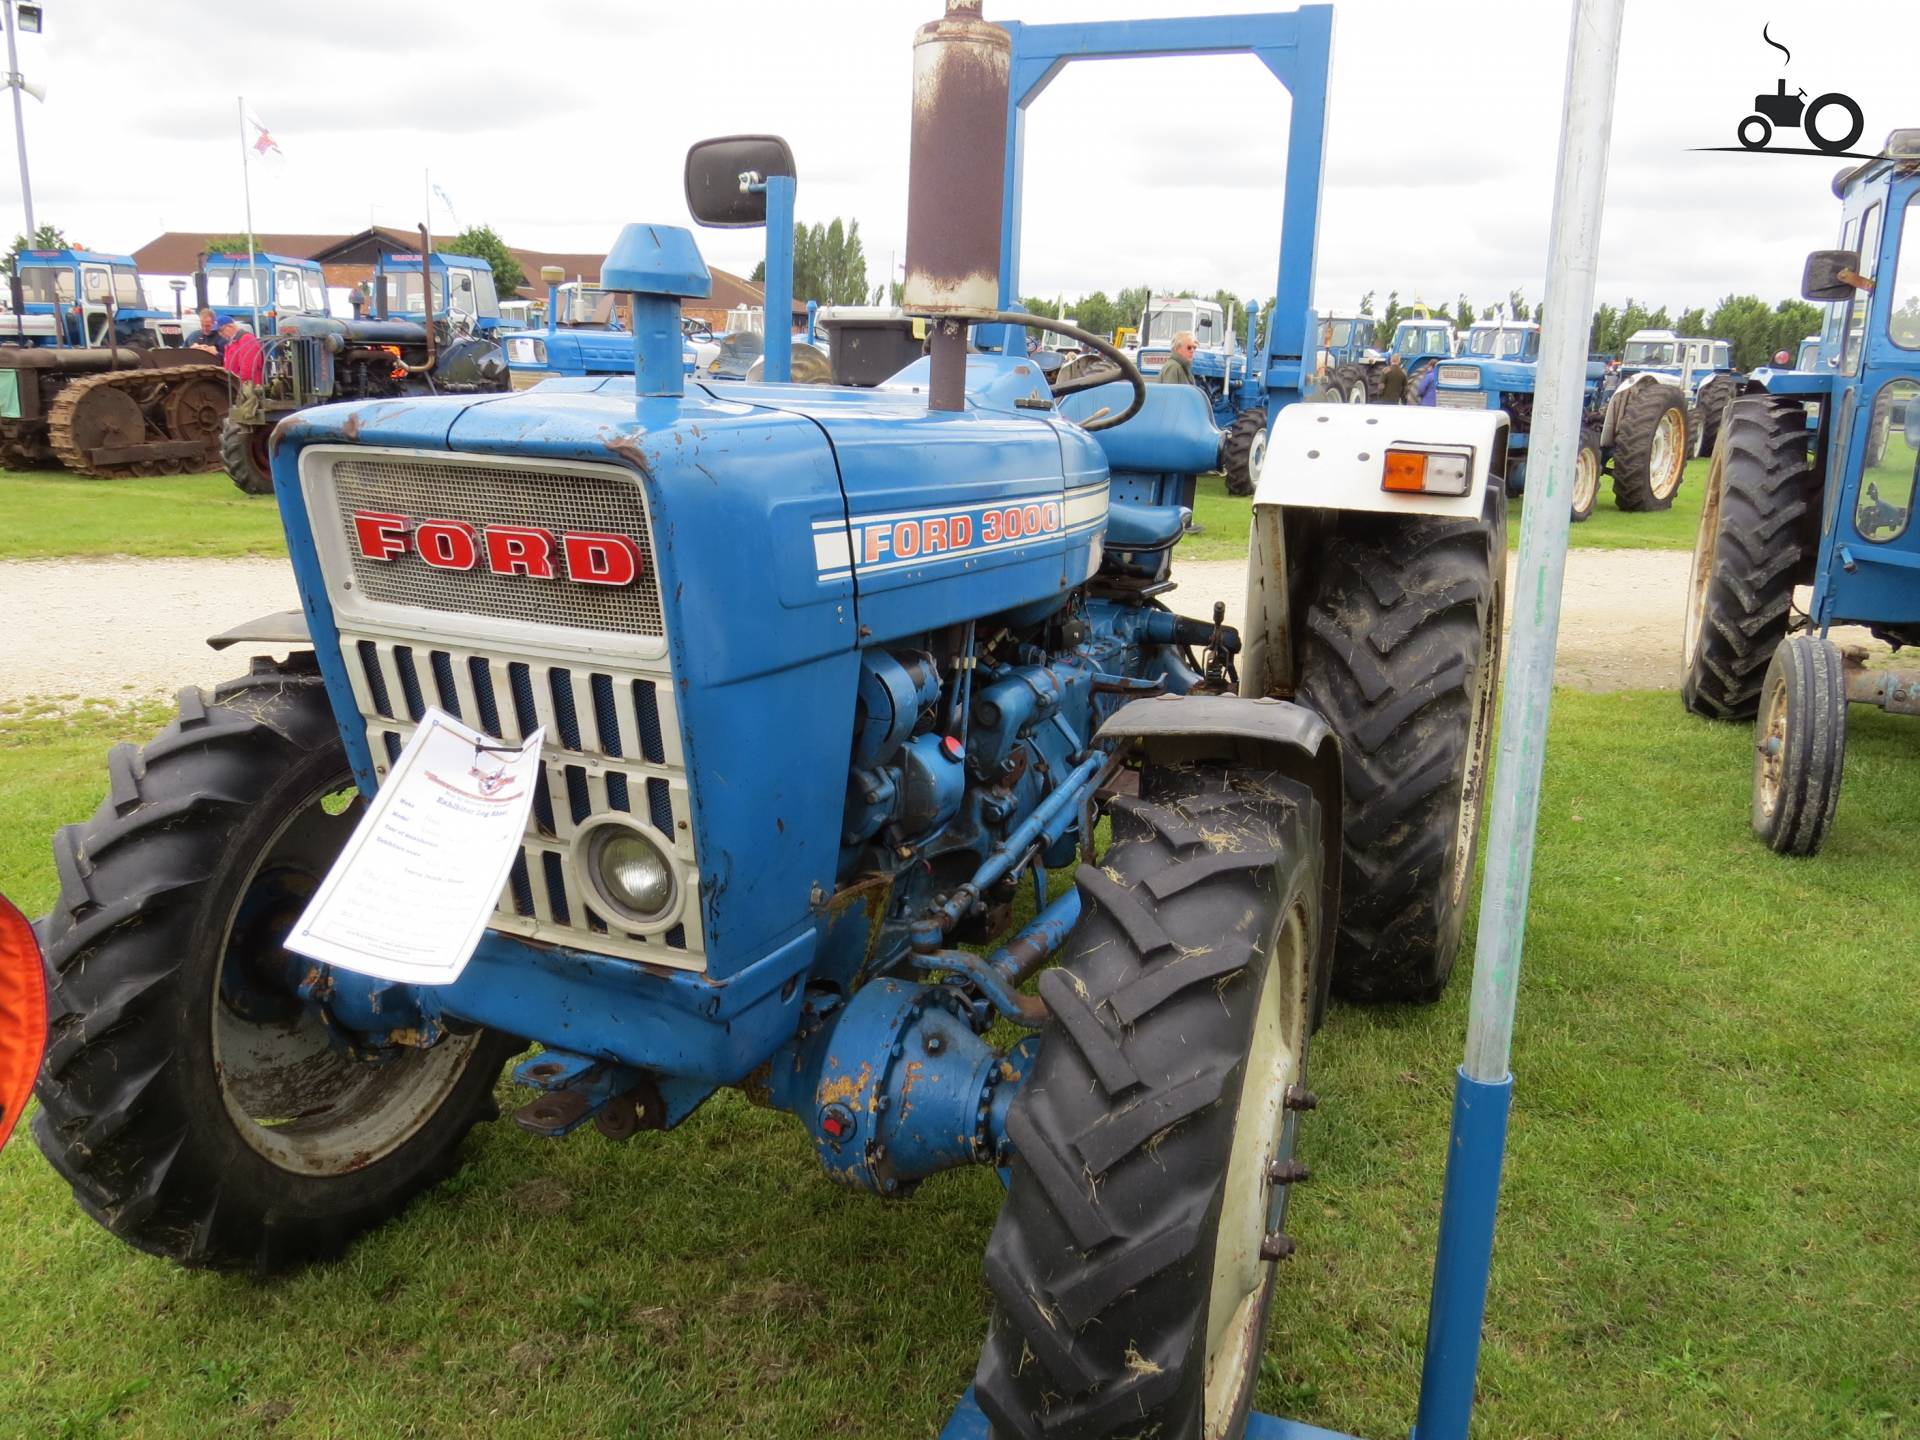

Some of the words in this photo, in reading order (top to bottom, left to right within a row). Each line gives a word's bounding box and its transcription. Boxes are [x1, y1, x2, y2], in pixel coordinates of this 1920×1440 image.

[353, 510, 642, 586] FORD
[864, 514, 973, 562] FORD
[982, 502, 1059, 543] 3000
